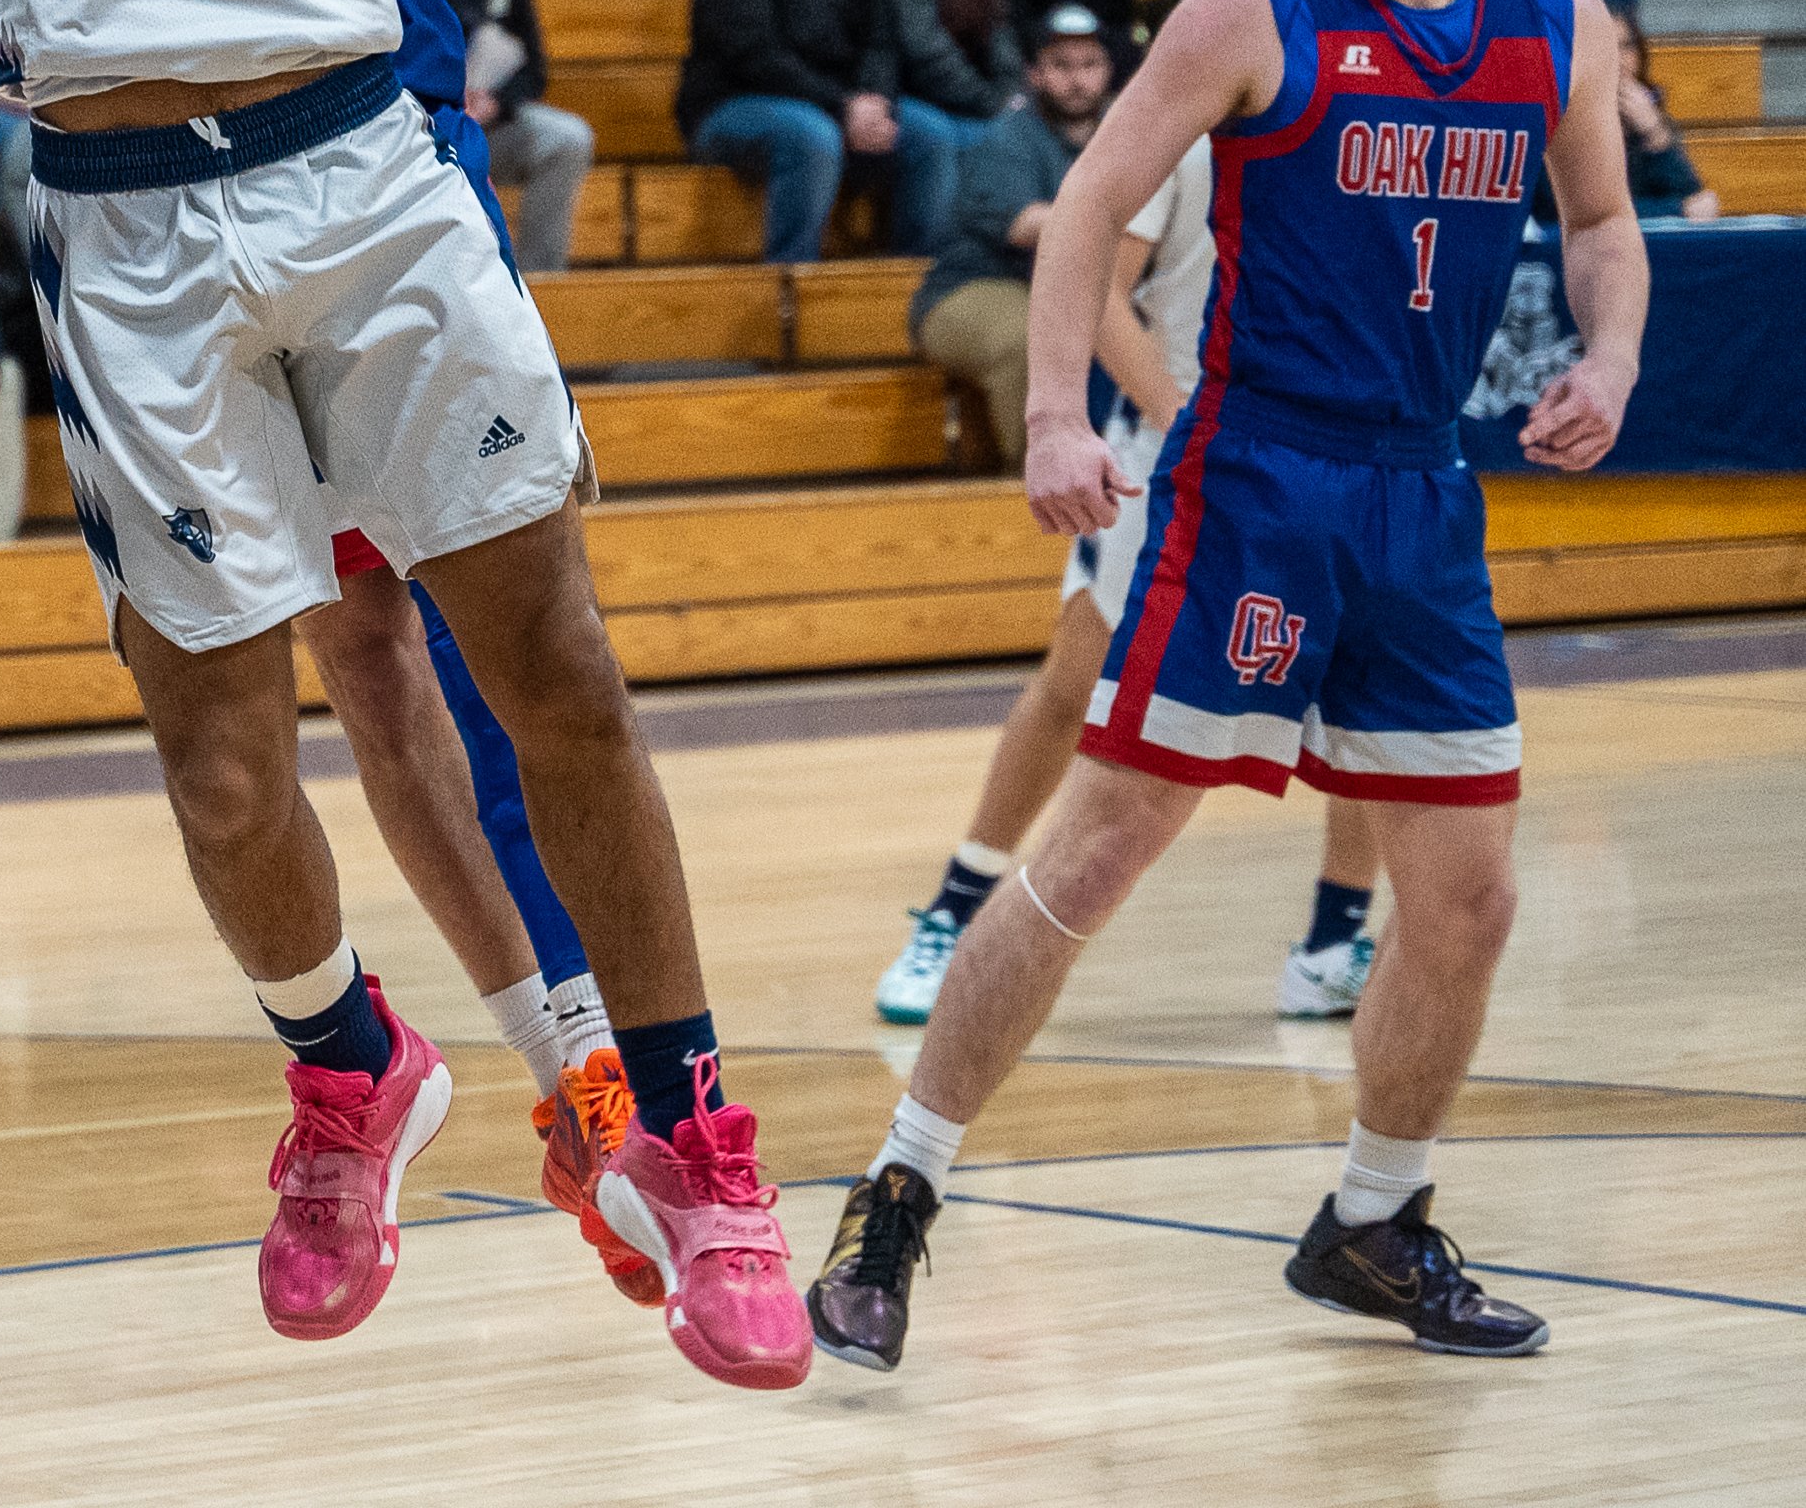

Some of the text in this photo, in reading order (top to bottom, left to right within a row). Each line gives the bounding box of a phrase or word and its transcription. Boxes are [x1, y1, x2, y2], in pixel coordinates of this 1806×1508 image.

[1336, 120, 1529, 203] OAK HILL
[1408, 218, 1439, 312] 1
[478, 432, 526, 458] adidas
